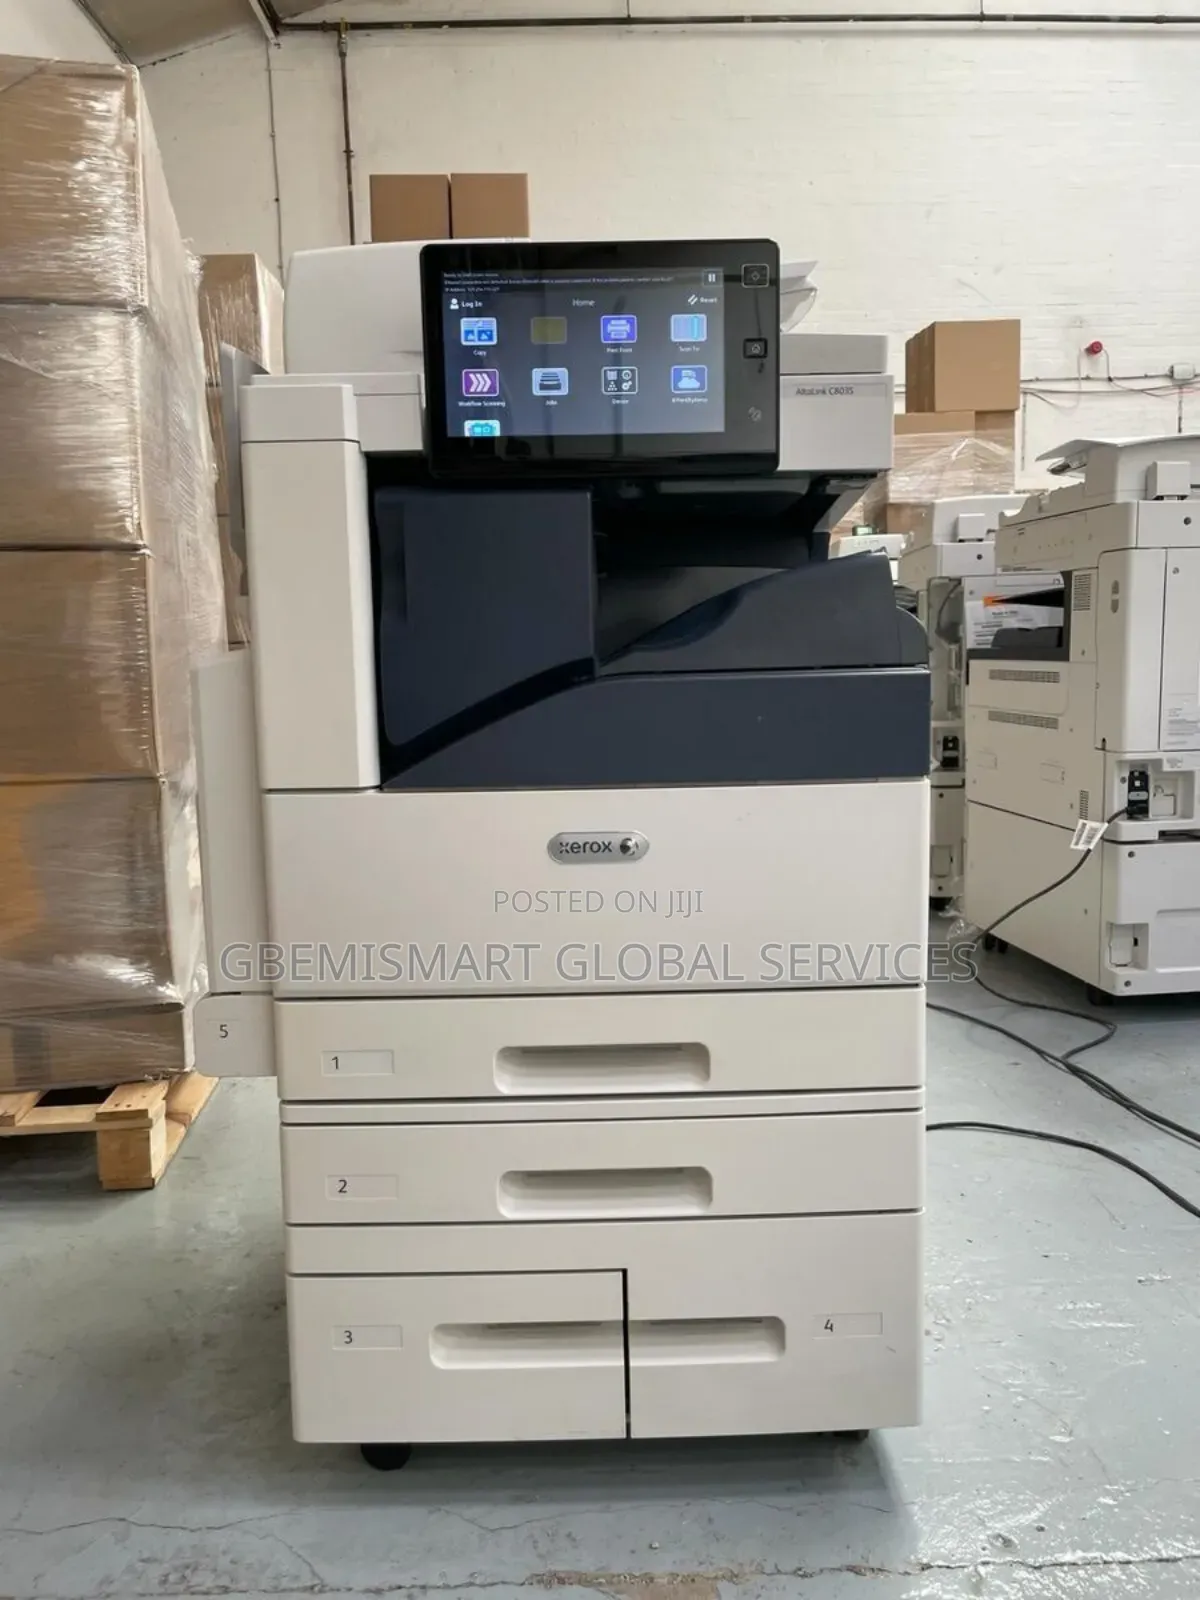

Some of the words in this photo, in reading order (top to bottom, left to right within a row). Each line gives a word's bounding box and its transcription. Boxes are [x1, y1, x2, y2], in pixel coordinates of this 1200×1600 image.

[461, 300, 474, 308] Log
[572, 298, 596, 307] Home
[559, 840, 613, 854] xerox
[219, 1024, 229, 1039] 5
[331, 1056, 339, 1070] 1
[338, 1179, 348, 1194] 2
[823, 1319, 834, 1333] 4
[343, 1330, 353, 1344] 3
